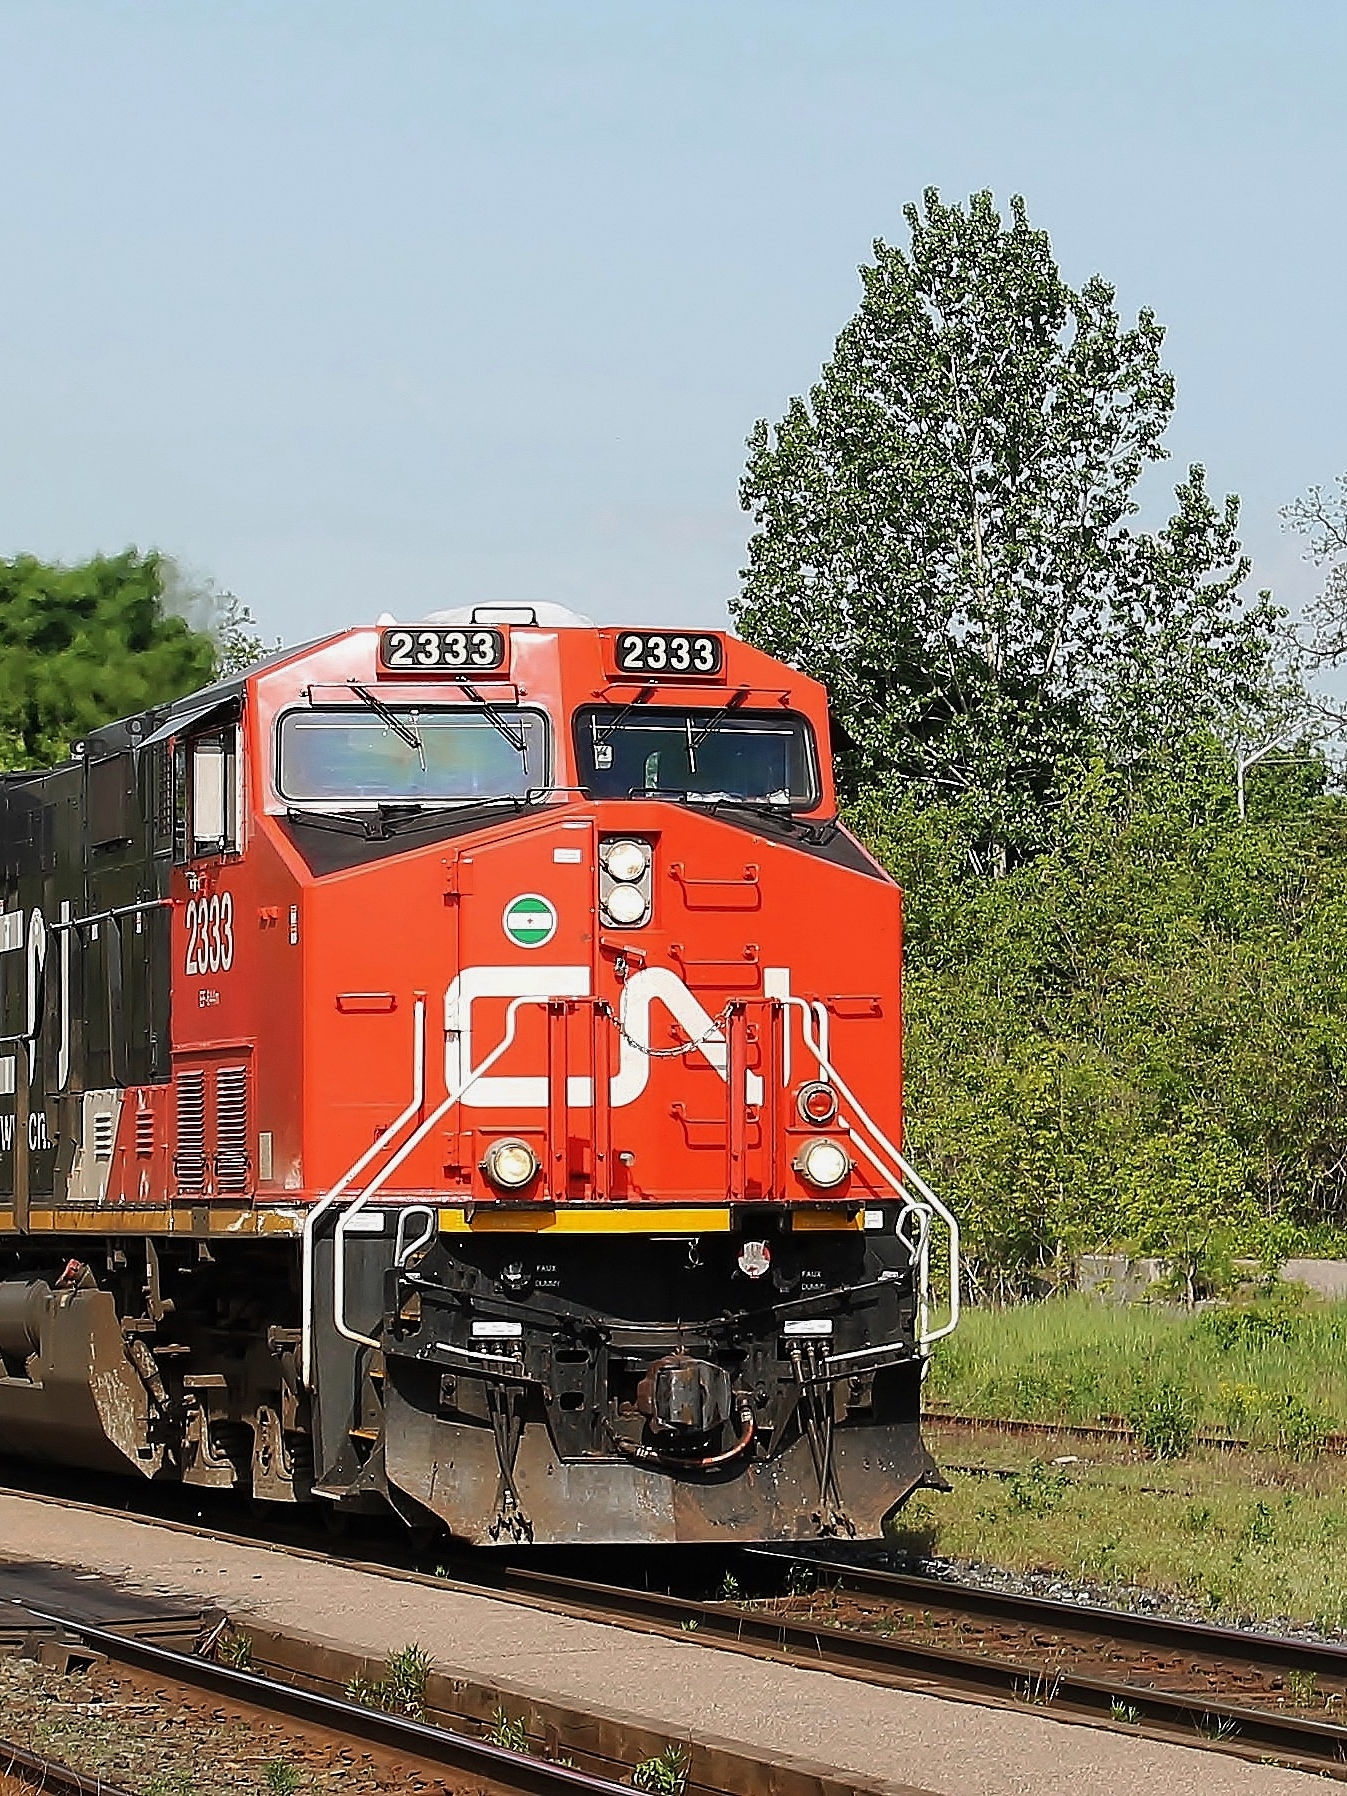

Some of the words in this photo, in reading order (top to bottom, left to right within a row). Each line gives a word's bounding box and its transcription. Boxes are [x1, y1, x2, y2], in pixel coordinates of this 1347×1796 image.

[390, 632, 495, 665] 2333
[623, 636, 714, 671] 2333
[185, 891, 234, 976] 2333
[444, 966, 791, 1109] CN
[536, 1264, 558, 1273] FAUX
[801, 1269, 823, 1279] FAUX
